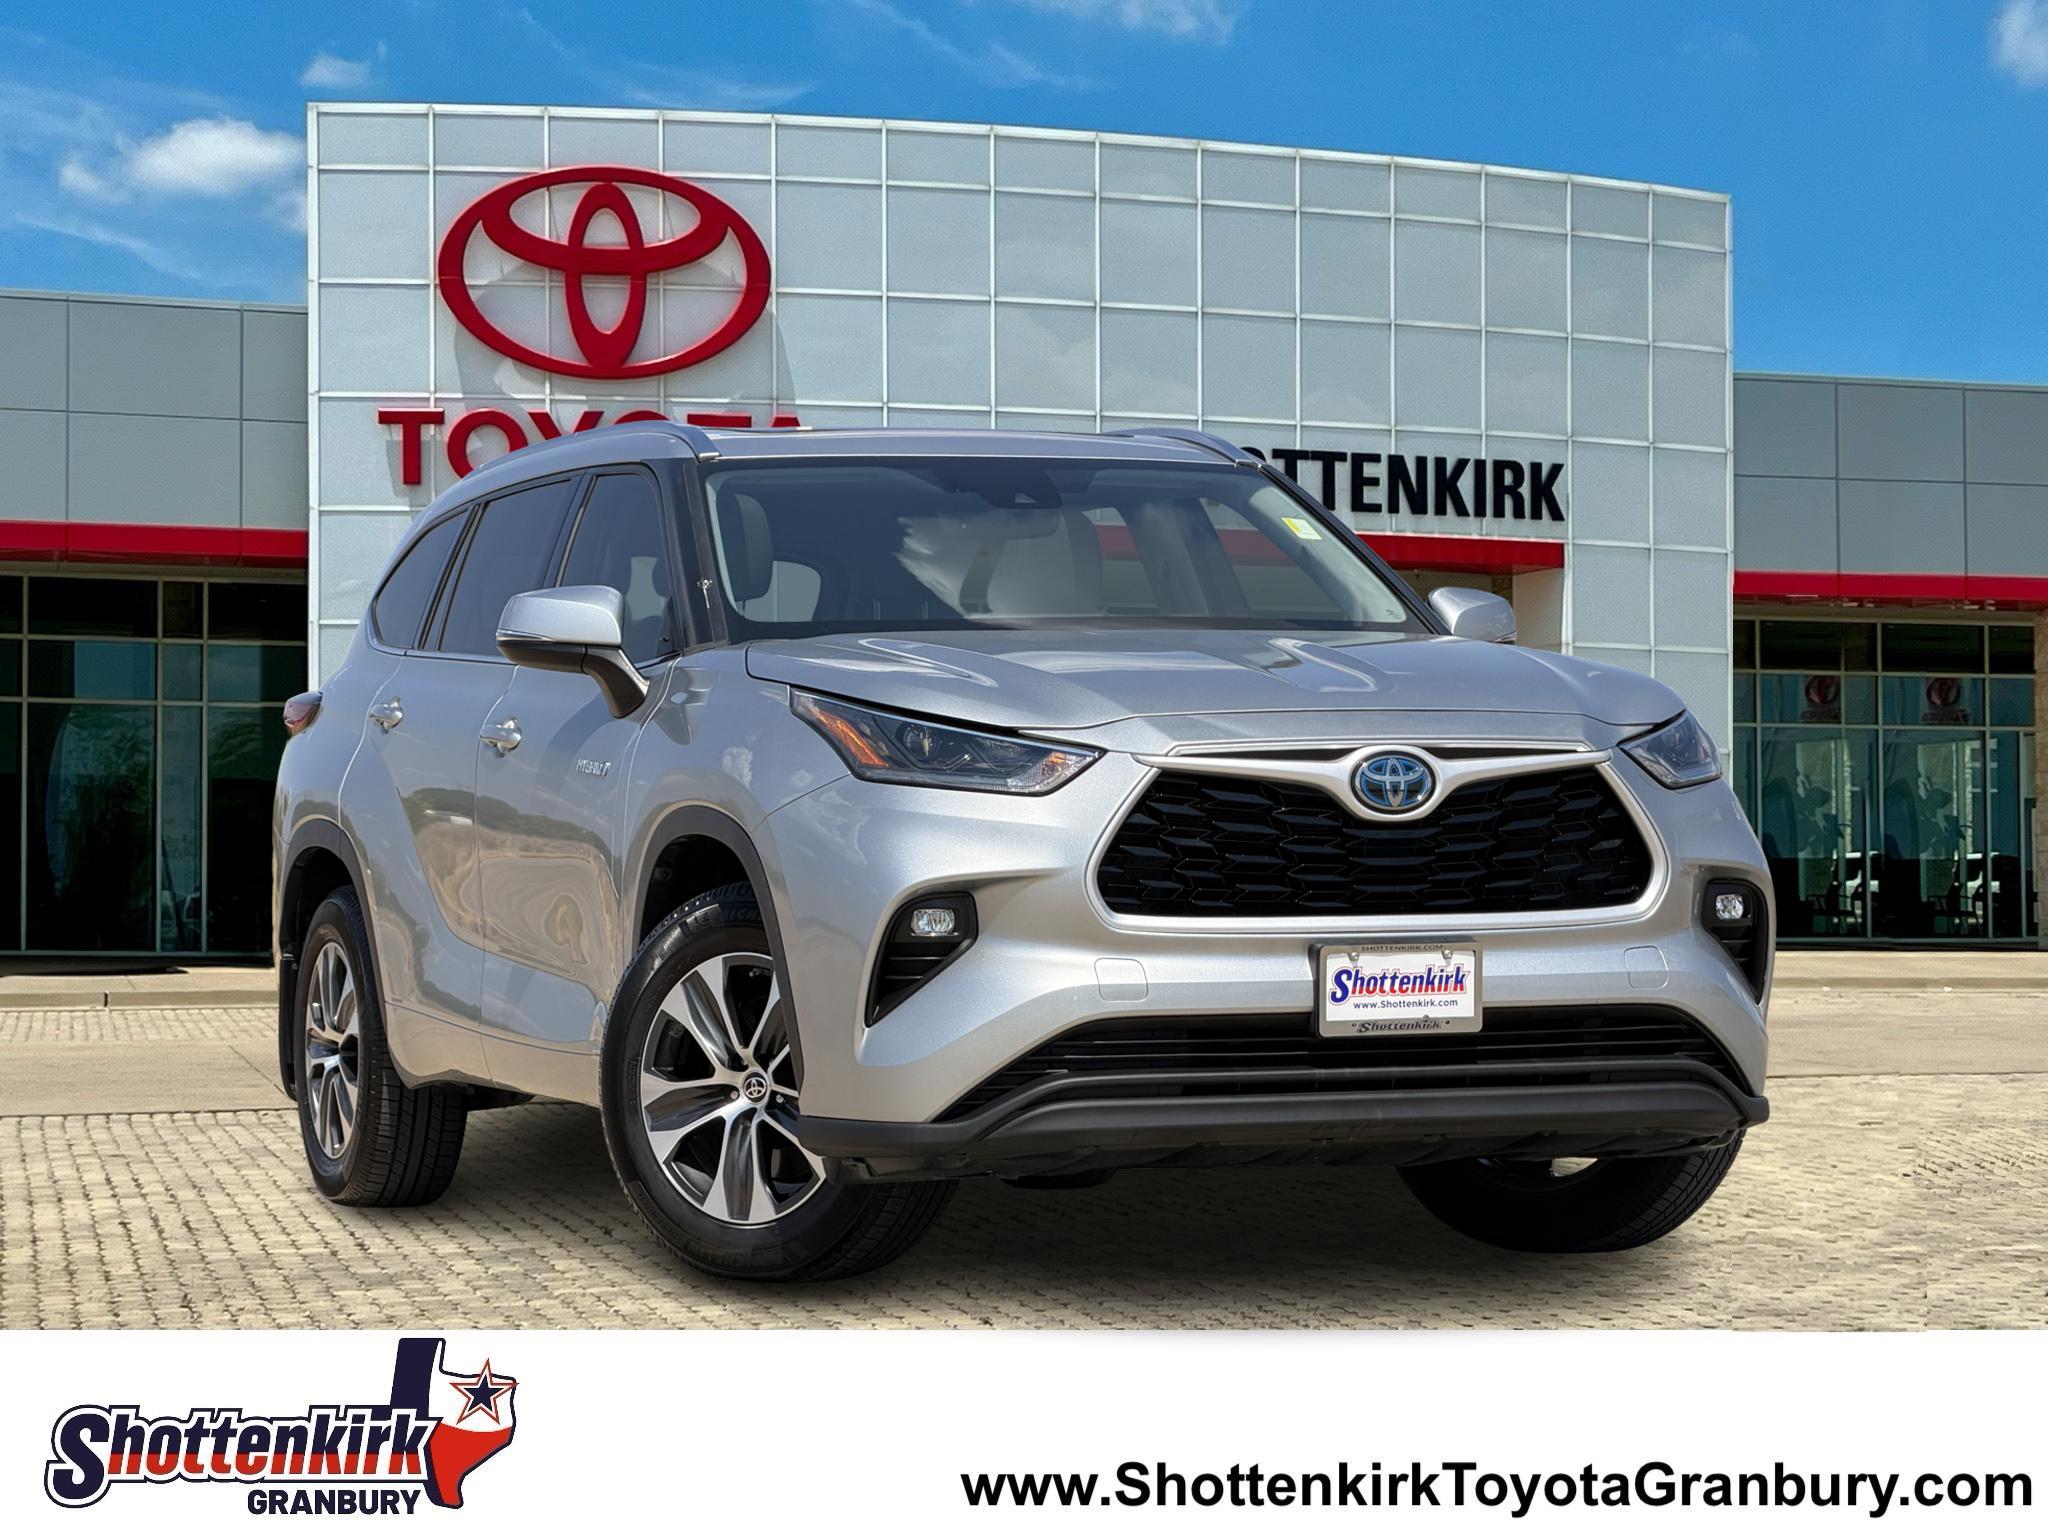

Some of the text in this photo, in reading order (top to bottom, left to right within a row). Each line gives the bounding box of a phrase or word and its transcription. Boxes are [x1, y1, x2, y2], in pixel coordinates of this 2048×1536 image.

[1240, 446, 1565, 522] TTENKIRK
[1330, 965, 1467, 1004] Shottenkirk
[1353, 999, 1458, 1010] www.Shottenkirk.com
[1357, 1020, 1441, 1033] Shottenkirk
